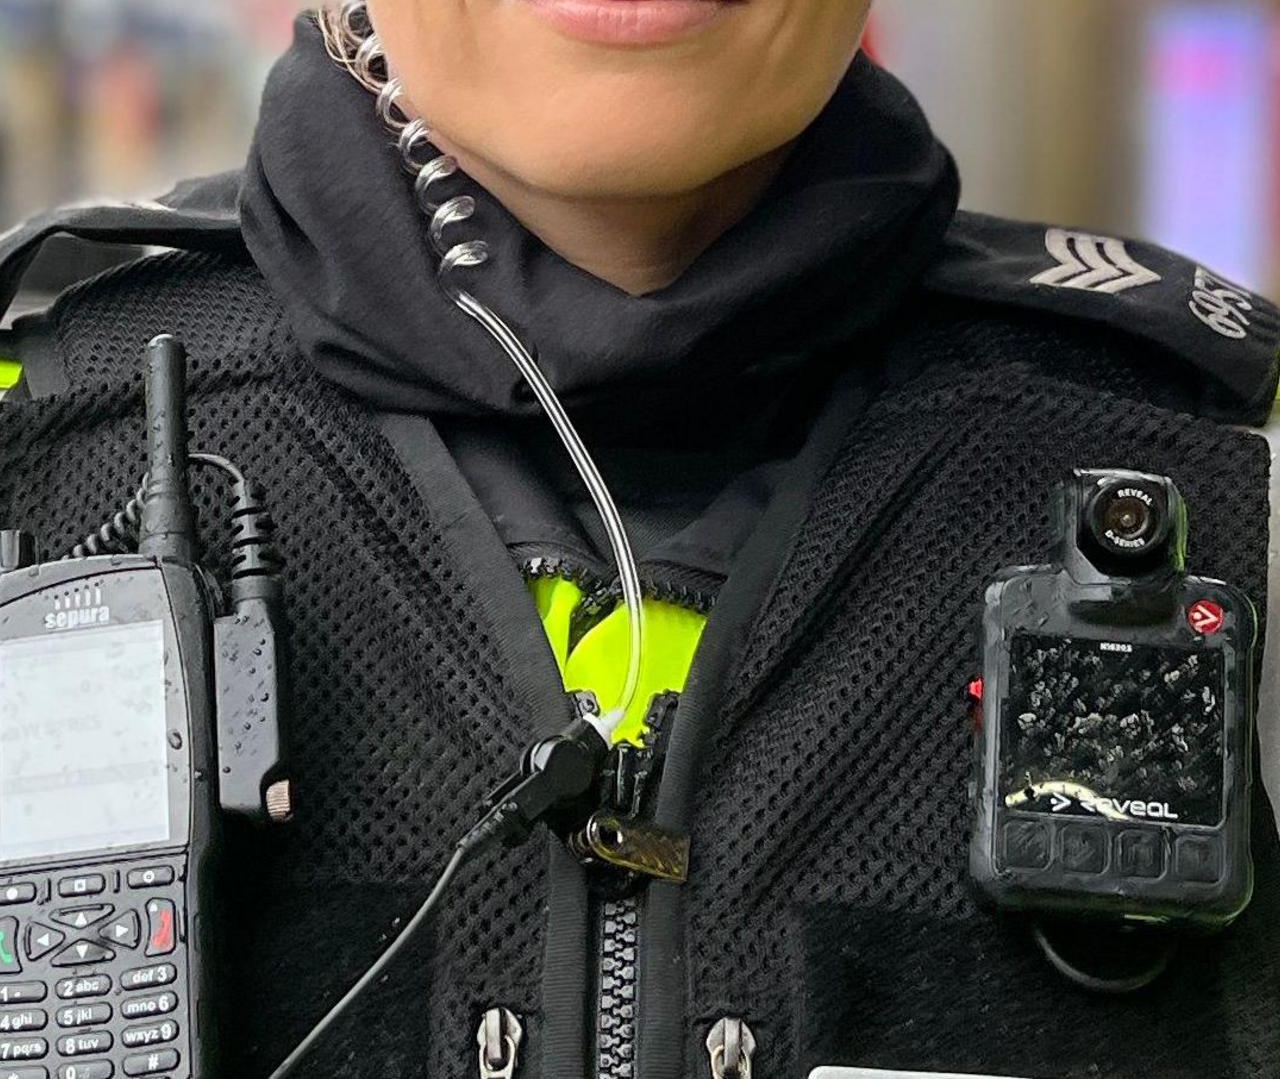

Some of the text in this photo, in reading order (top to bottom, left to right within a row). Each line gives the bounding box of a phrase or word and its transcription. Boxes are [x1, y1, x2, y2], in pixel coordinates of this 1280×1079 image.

[1117, 487, 1153, 506] REVEAL
[45, 606, 110, 630] sepura
[132, 966, 168, 984] def 3
[63, 980, 100, 997] 2 abc
[127, 995, 169, 1013] mno 6
[0, 1012, 33, 1030] 4 ghi
[63, 1009, 73, 1025] 5
[125, 1023, 172, 1044] wxyz 9
[1, 1042, 42, 1059] 7 pqrs
[65, 1038, 99, 1055] 8 tuv
